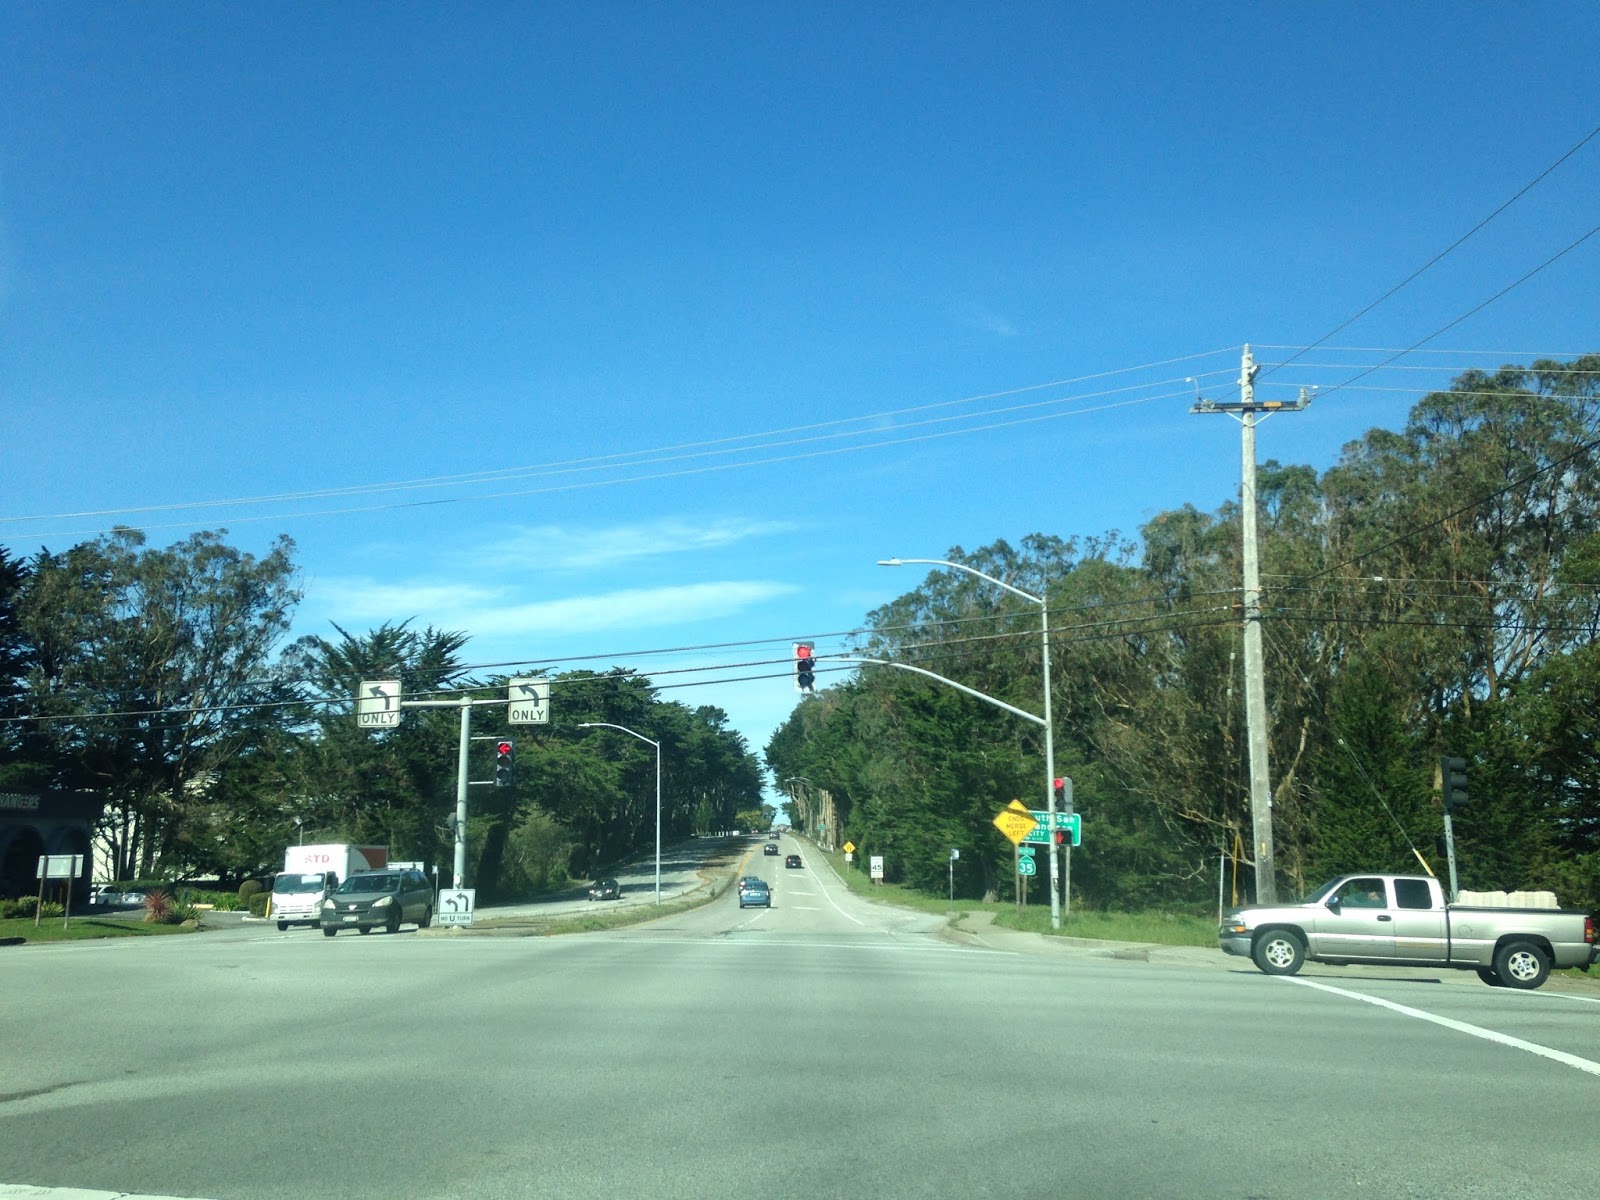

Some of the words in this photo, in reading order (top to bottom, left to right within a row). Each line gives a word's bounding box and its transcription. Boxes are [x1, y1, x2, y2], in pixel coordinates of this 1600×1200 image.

[362, 713, 395, 724] ONLY
[512, 710, 544, 721] ONLY
[1056, 814, 1075, 823] San
[1019, 863, 1033, 873] 35
